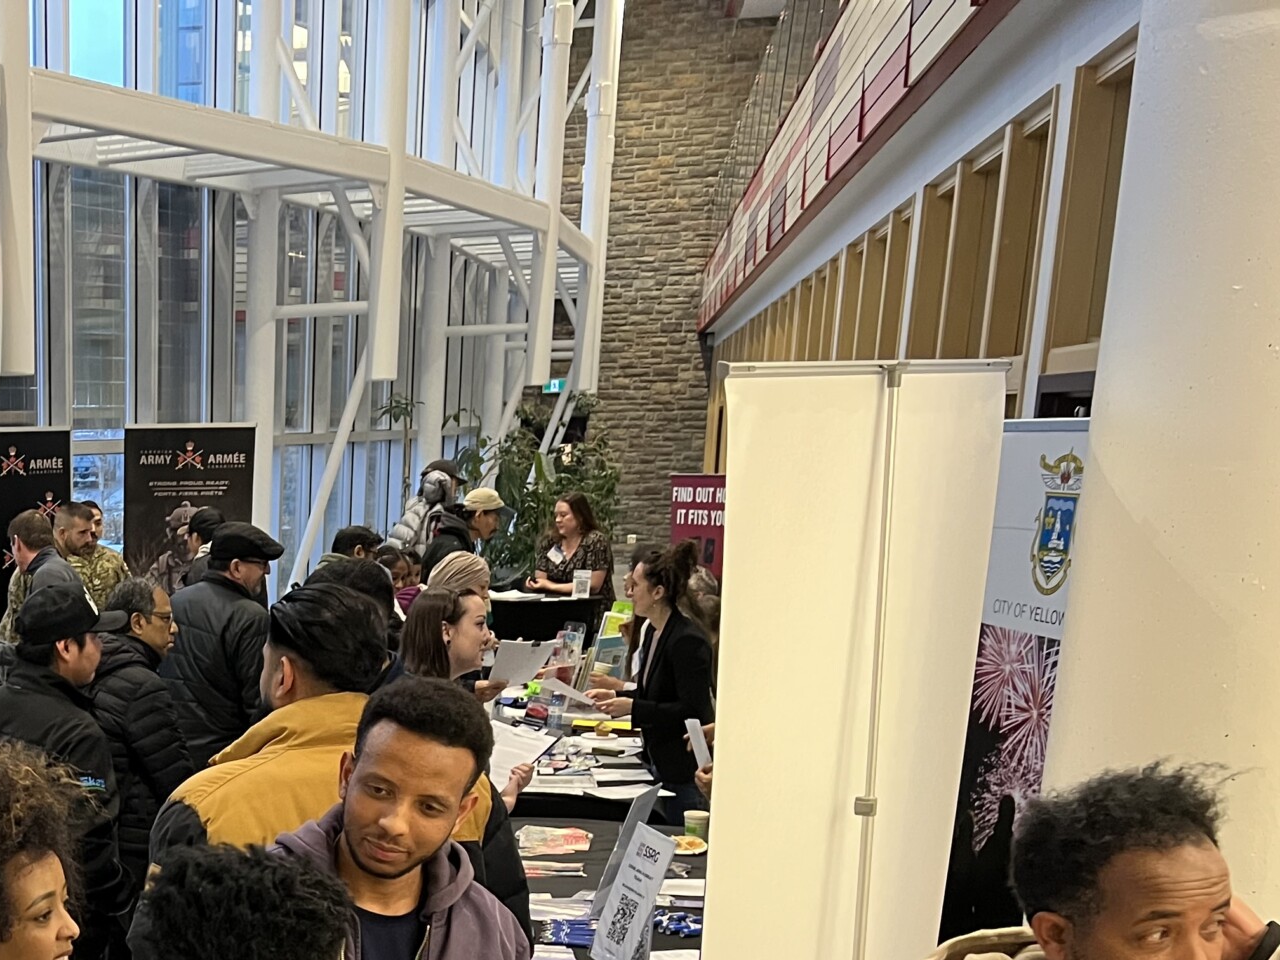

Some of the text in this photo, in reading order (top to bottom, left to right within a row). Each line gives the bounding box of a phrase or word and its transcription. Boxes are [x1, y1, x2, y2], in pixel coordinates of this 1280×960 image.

[29, 457, 63, 469] ARMÉE
[139, 452, 246, 465] ARMY ARMÉE
[672, 486, 693, 502] FIND
[696, 486, 715, 503] OUT
[676, 509, 686, 524] IT
[688, 509, 708, 526] FITS
[993, 598, 1013, 616] CITY
[1013, 602, 1028, 618] OF
